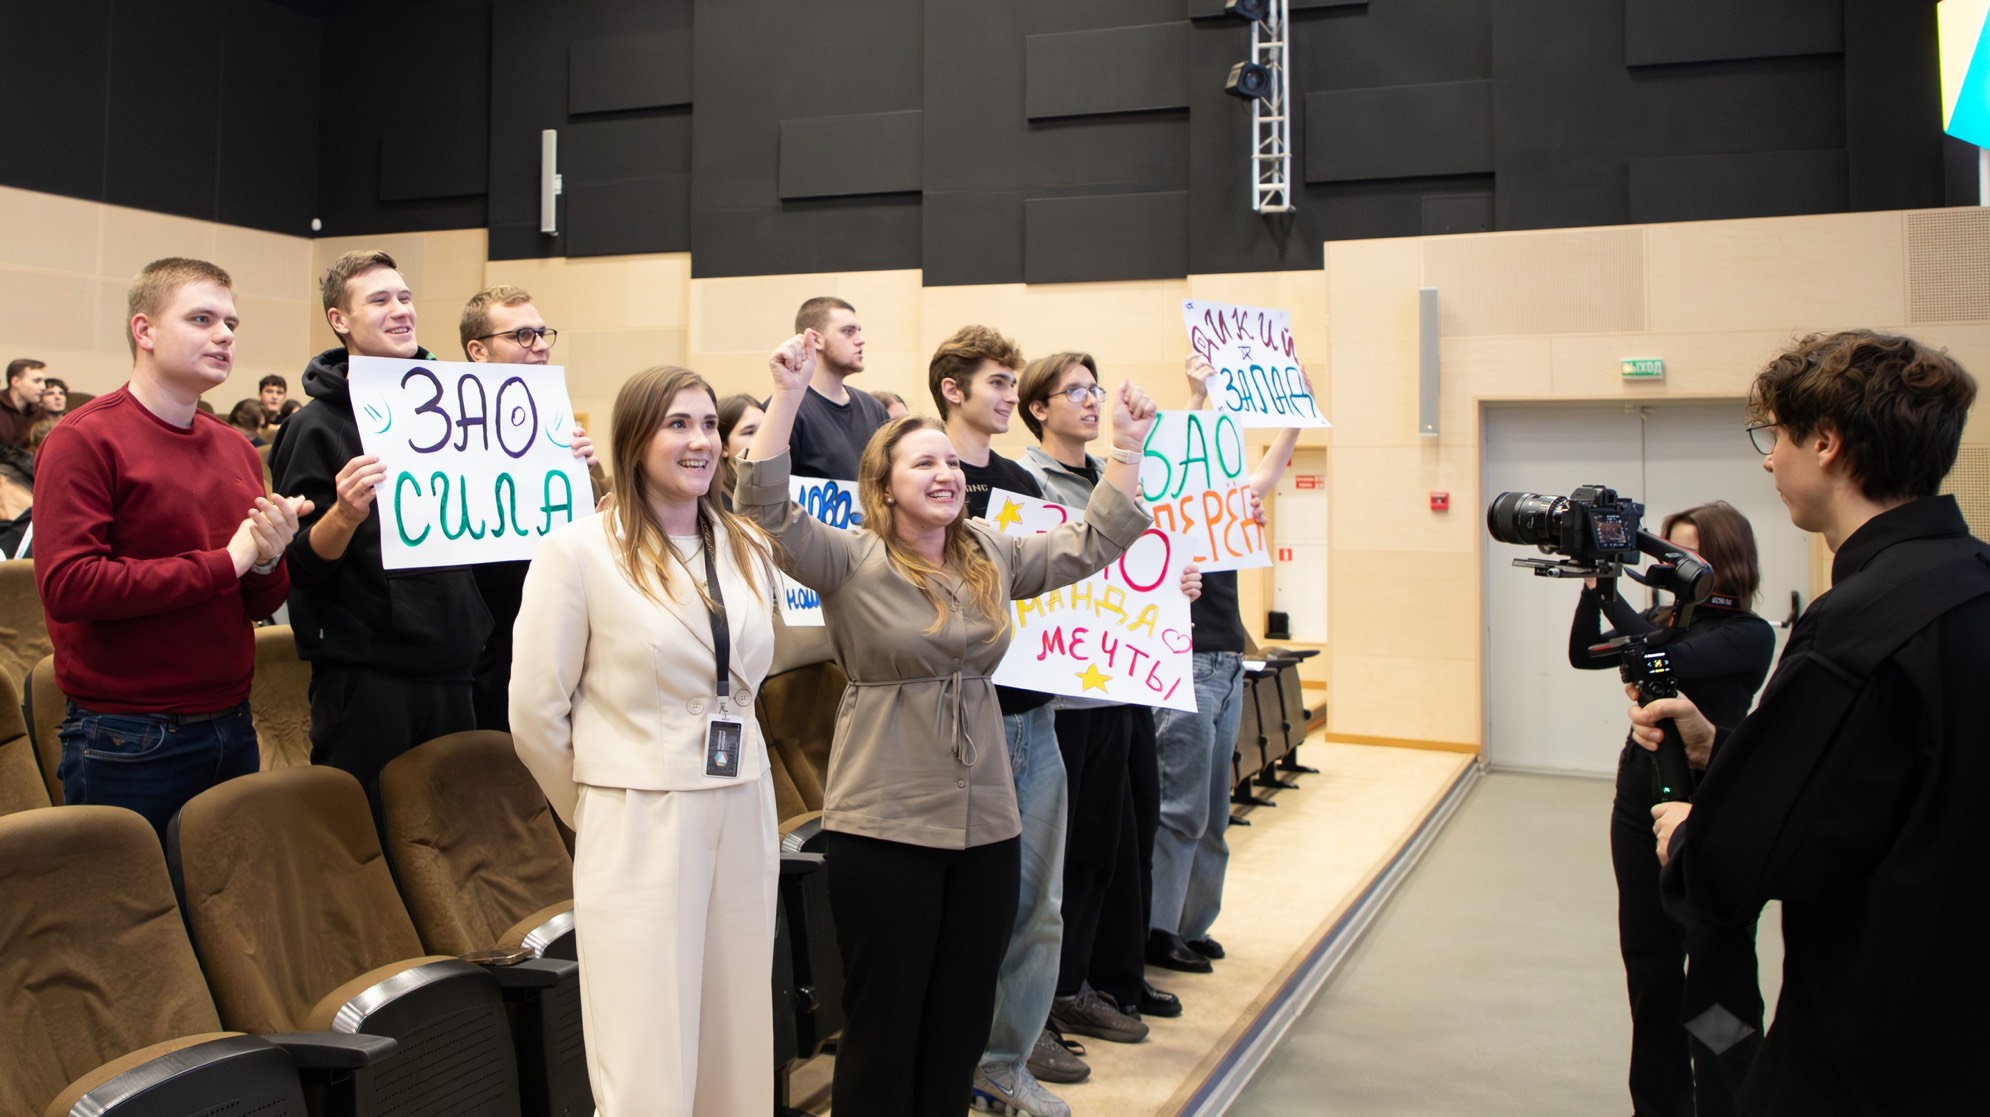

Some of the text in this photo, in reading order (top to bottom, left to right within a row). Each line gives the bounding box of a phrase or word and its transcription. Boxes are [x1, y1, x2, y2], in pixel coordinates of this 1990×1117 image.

[1192, 307, 1300, 365] ДИКИЙ
[401, 366, 538, 459] ЗАО
[1220, 364, 1317, 419] ЗАПАД
[1141, 412, 1242, 502] ЗАО
[394, 469, 573, 548] СИЛА
[1010, 582, 1160, 642] МАНДА
[1037, 625, 1181, 701] МЕЧТЫ
